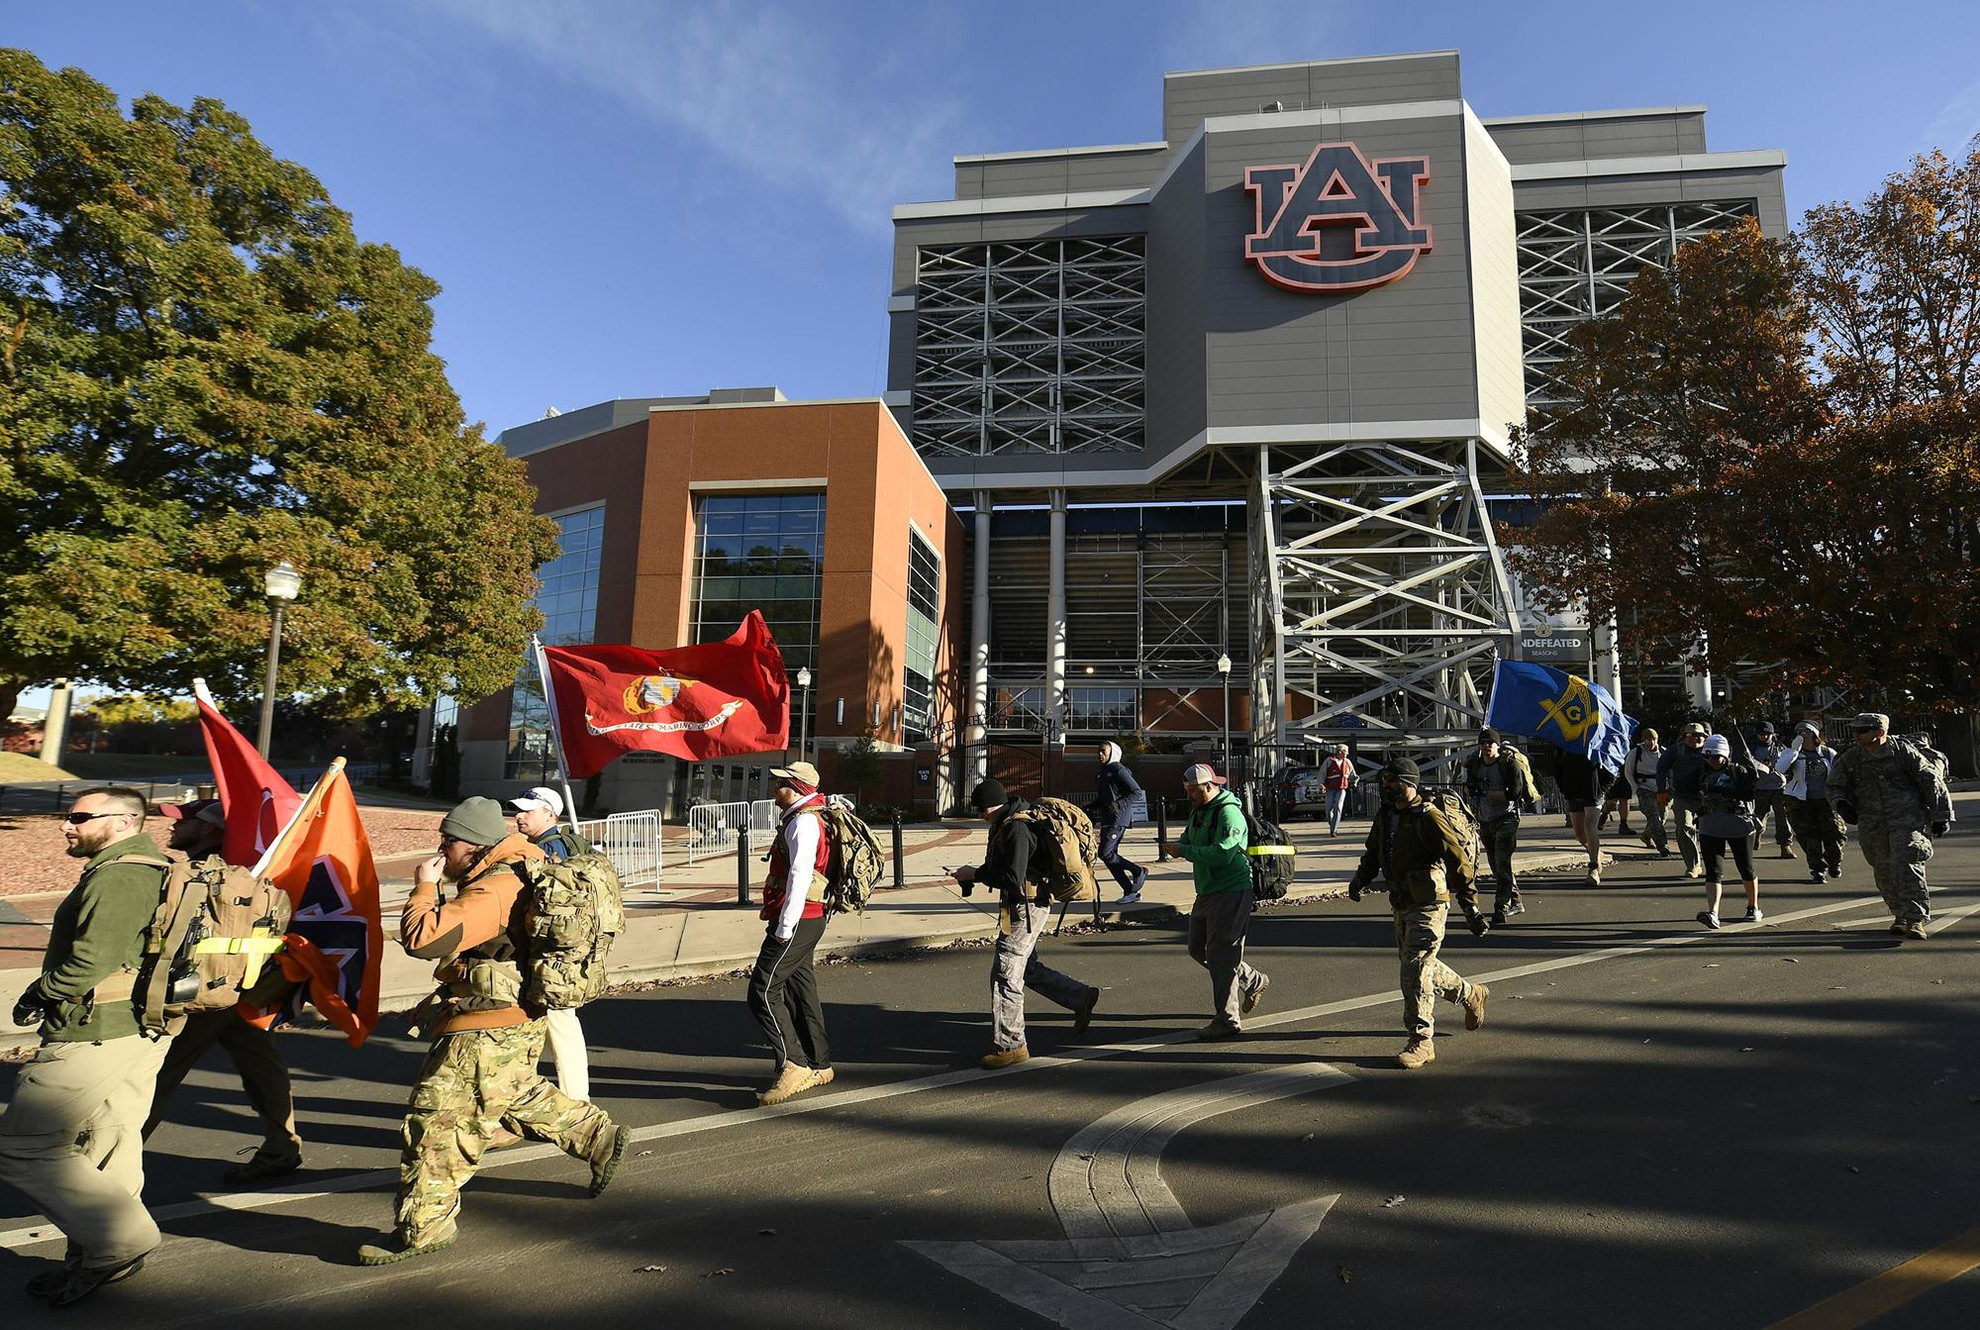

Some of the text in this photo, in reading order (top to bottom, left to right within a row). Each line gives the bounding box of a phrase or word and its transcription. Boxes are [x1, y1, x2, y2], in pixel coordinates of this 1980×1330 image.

[1521, 638, 1581, 648] NDEFEATED
[658, 721, 693, 732] MARINE
[697, 713, 729, 730] CORPS
